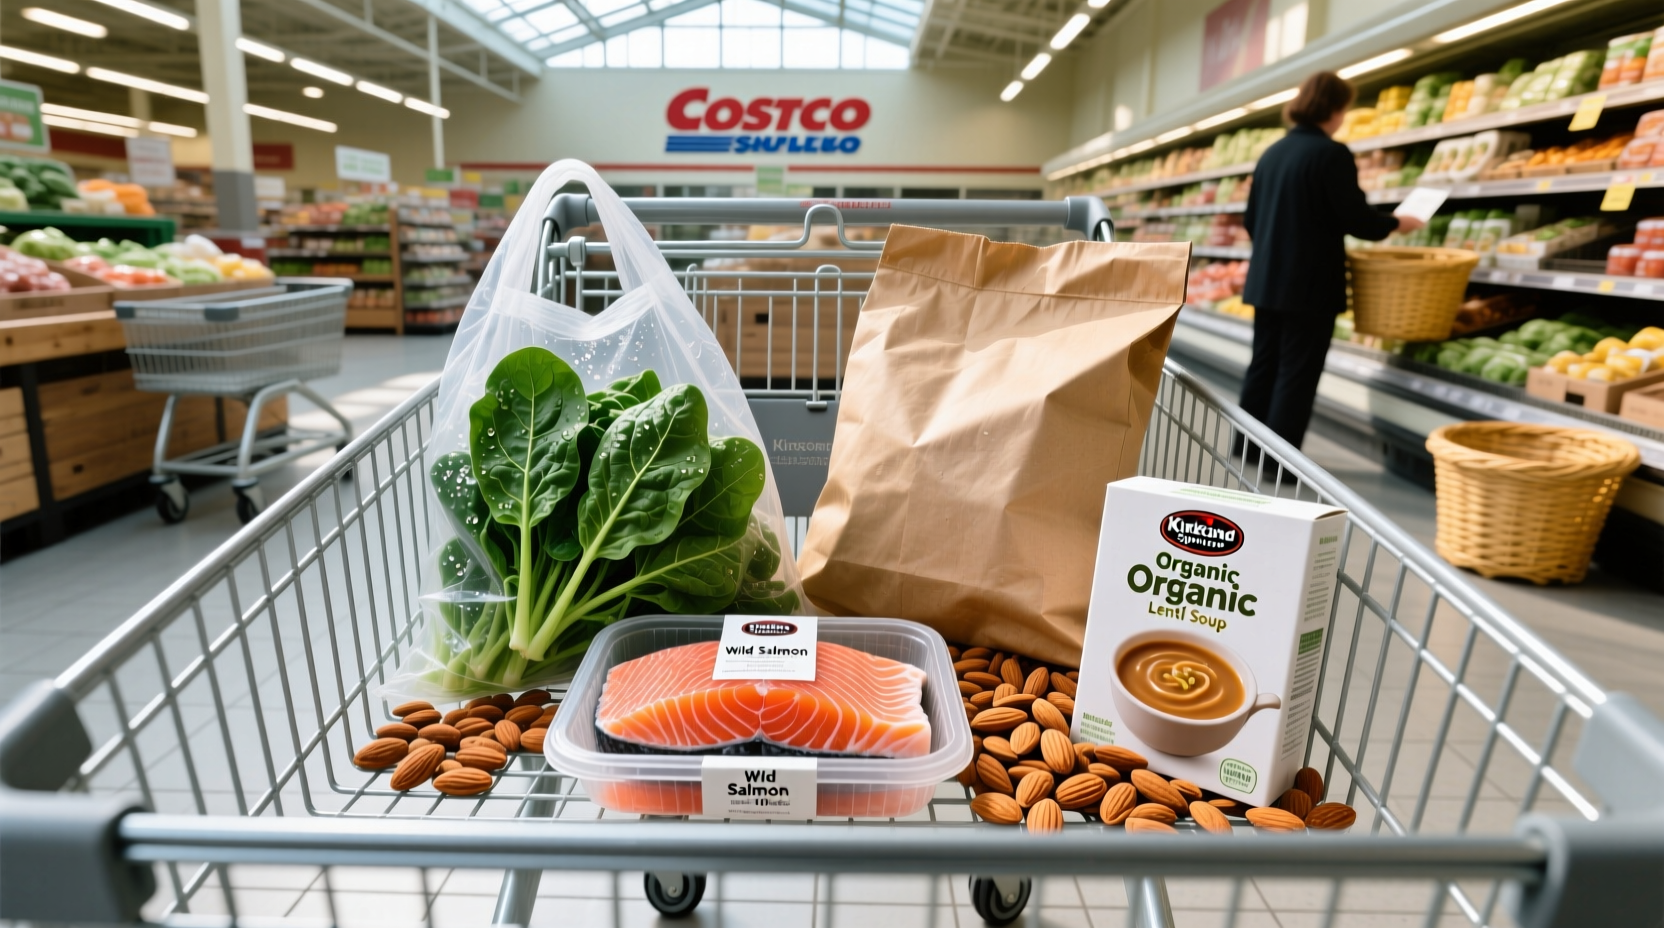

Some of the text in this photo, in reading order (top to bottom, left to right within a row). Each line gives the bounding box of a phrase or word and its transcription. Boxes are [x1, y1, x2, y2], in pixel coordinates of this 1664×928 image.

[666, 87, 871, 131] COSTCO
[1156, 552, 1240, 584] Organic
[1127, 564, 1258, 617] Organic
[1189, 609, 1227, 633] Soup
[758, 645, 808, 656] Salmon
[727, 783, 789, 796] Salmon
